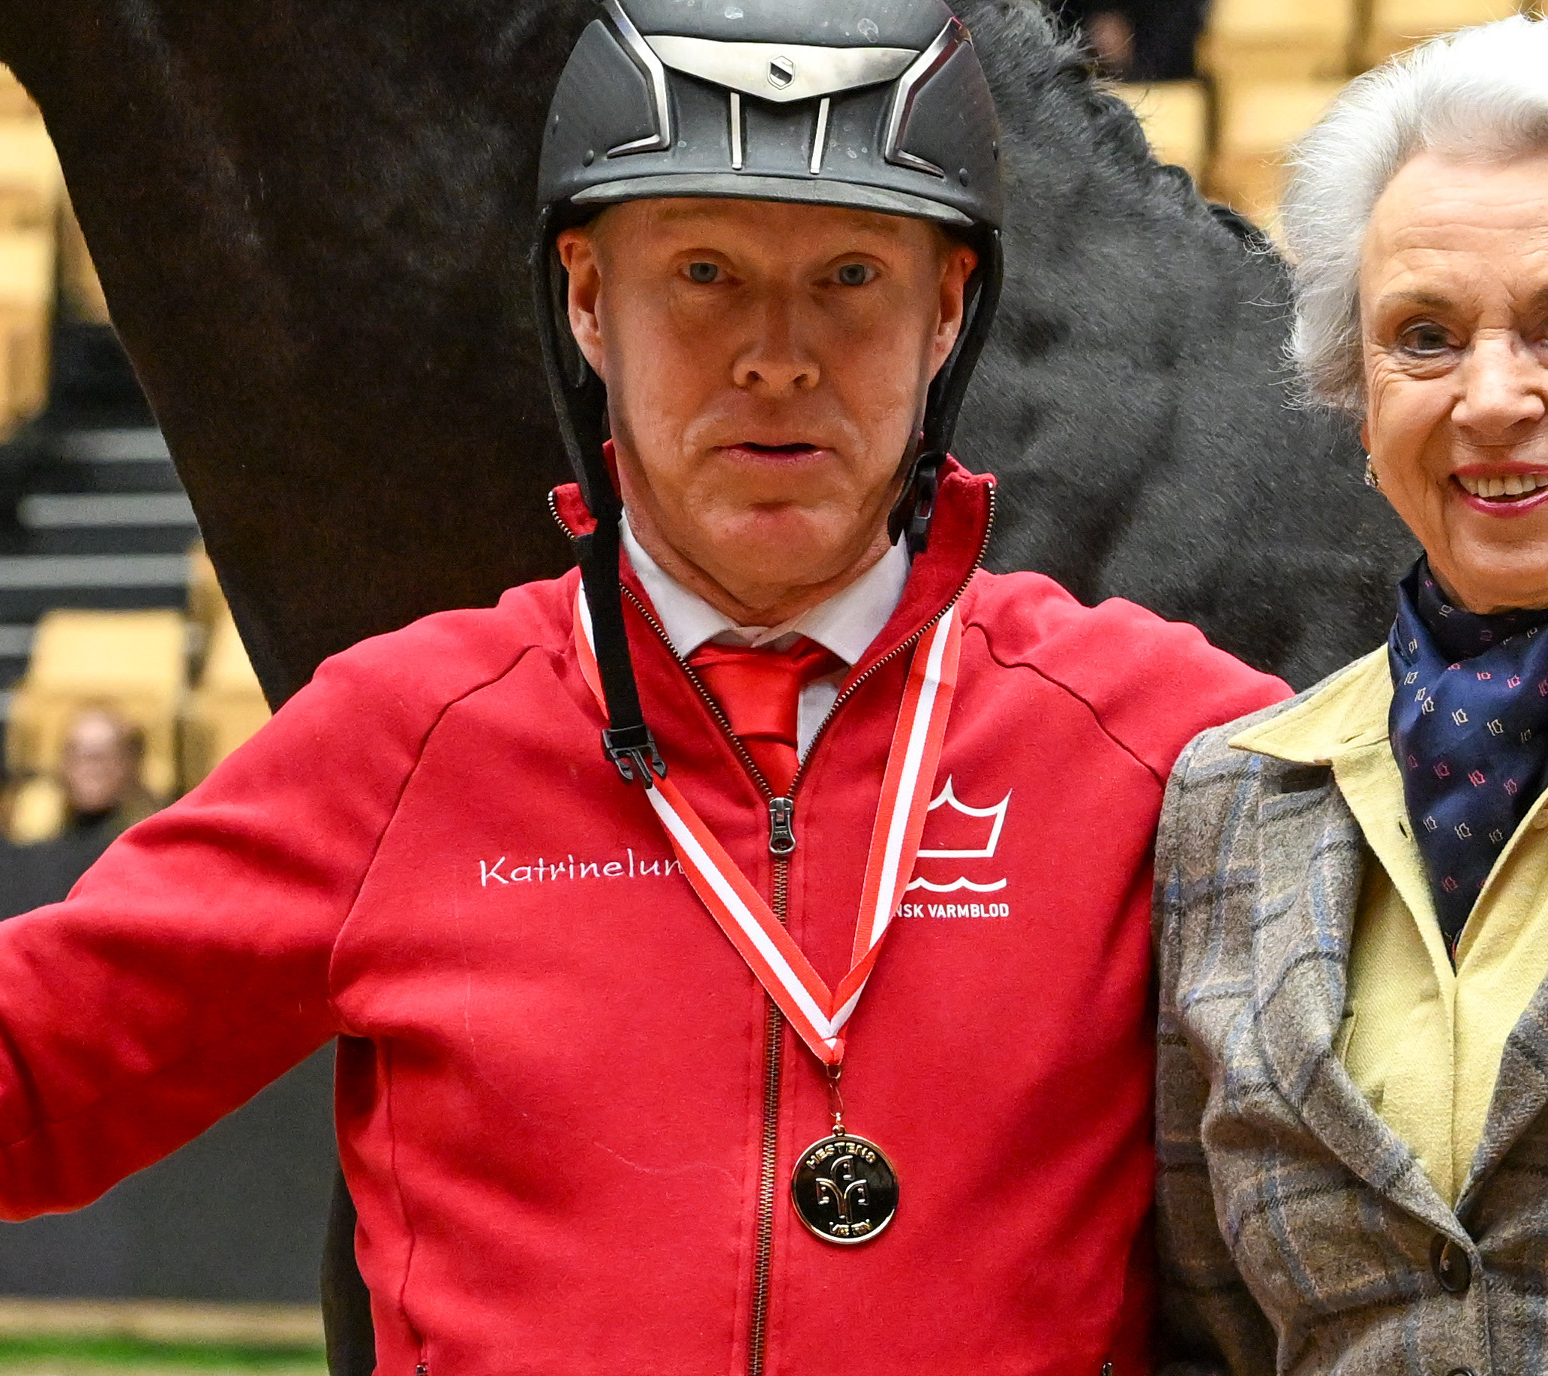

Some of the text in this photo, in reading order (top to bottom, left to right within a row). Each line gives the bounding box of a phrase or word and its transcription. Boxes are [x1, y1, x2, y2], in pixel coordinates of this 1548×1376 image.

[479, 847, 686, 887] Katrinelun
[893, 903, 1010, 918] NSK VARMBLOD
